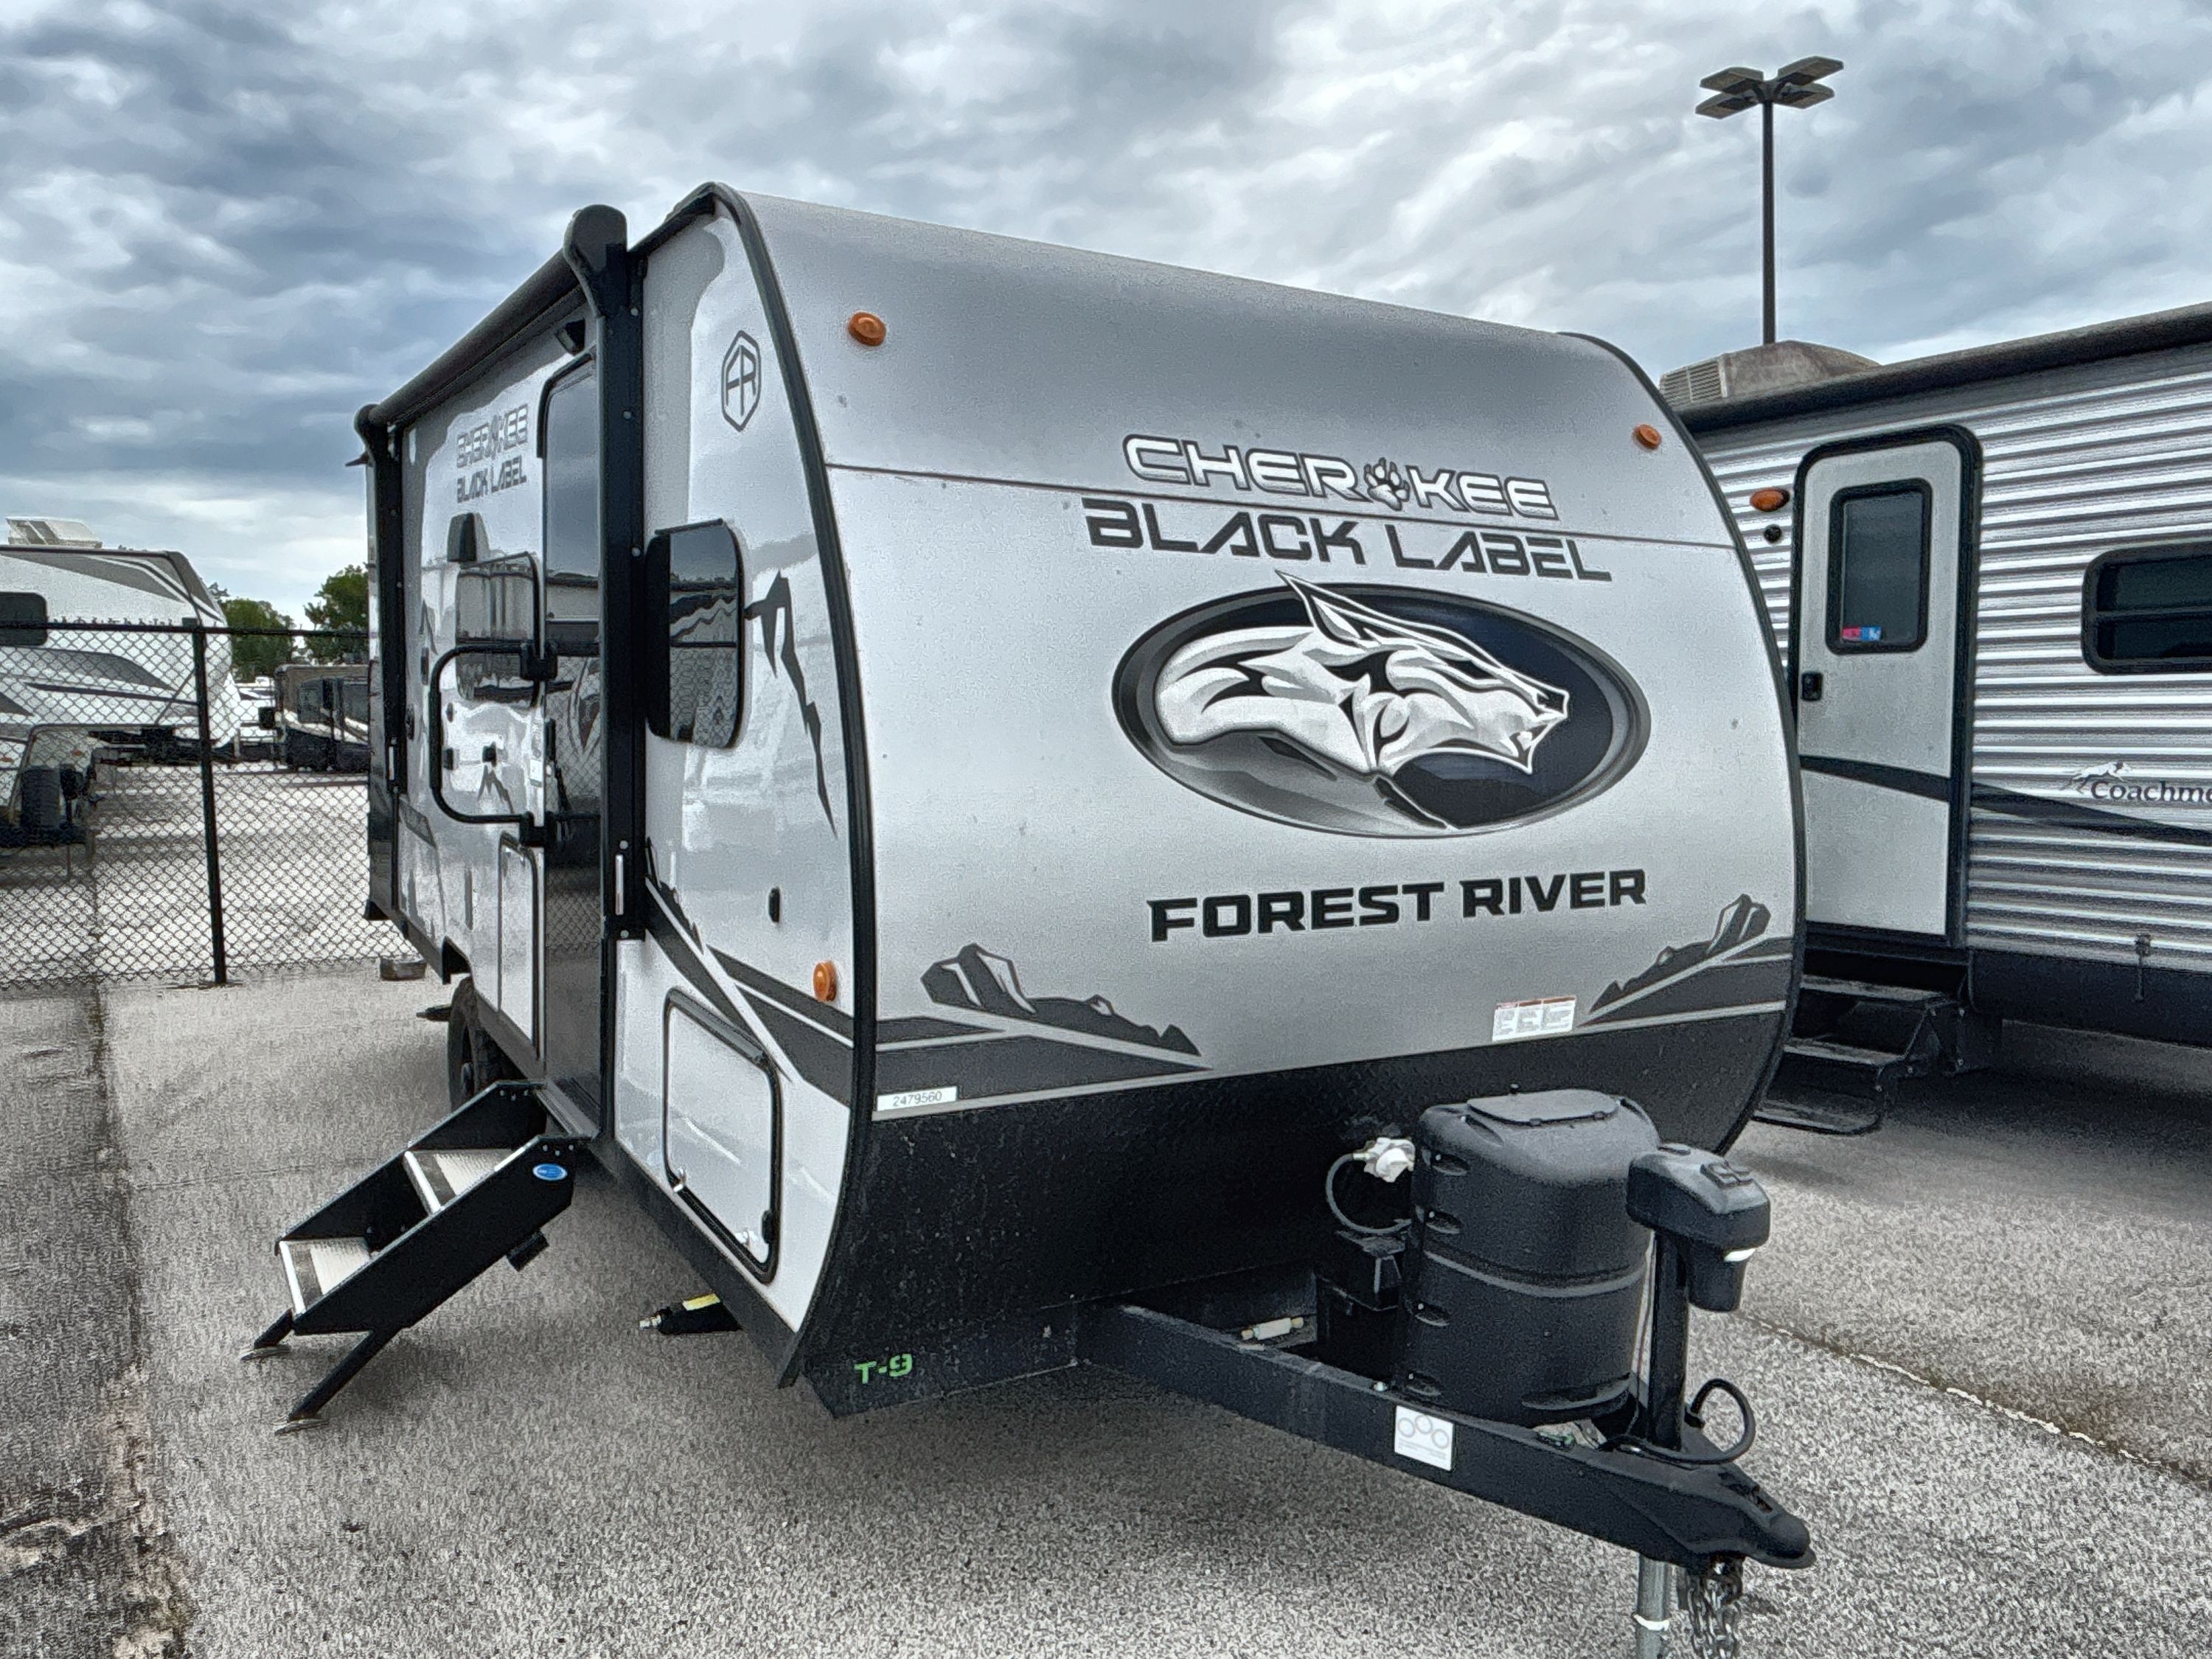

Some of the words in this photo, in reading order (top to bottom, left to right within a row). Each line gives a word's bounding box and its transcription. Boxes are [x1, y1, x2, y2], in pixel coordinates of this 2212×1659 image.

[457, 468, 489, 503] BLACK
[490, 454, 527, 493] LABEL
[1081, 497, 1366, 566] BLACK
[1385, 524, 1612, 582] LABEL
[1147, 882, 1444, 942] FOREST
[1458, 869, 1646, 919] RIVER
[893, 1091, 942, 1107] 2479560
[854, 1353, 913, 1384] T-9
